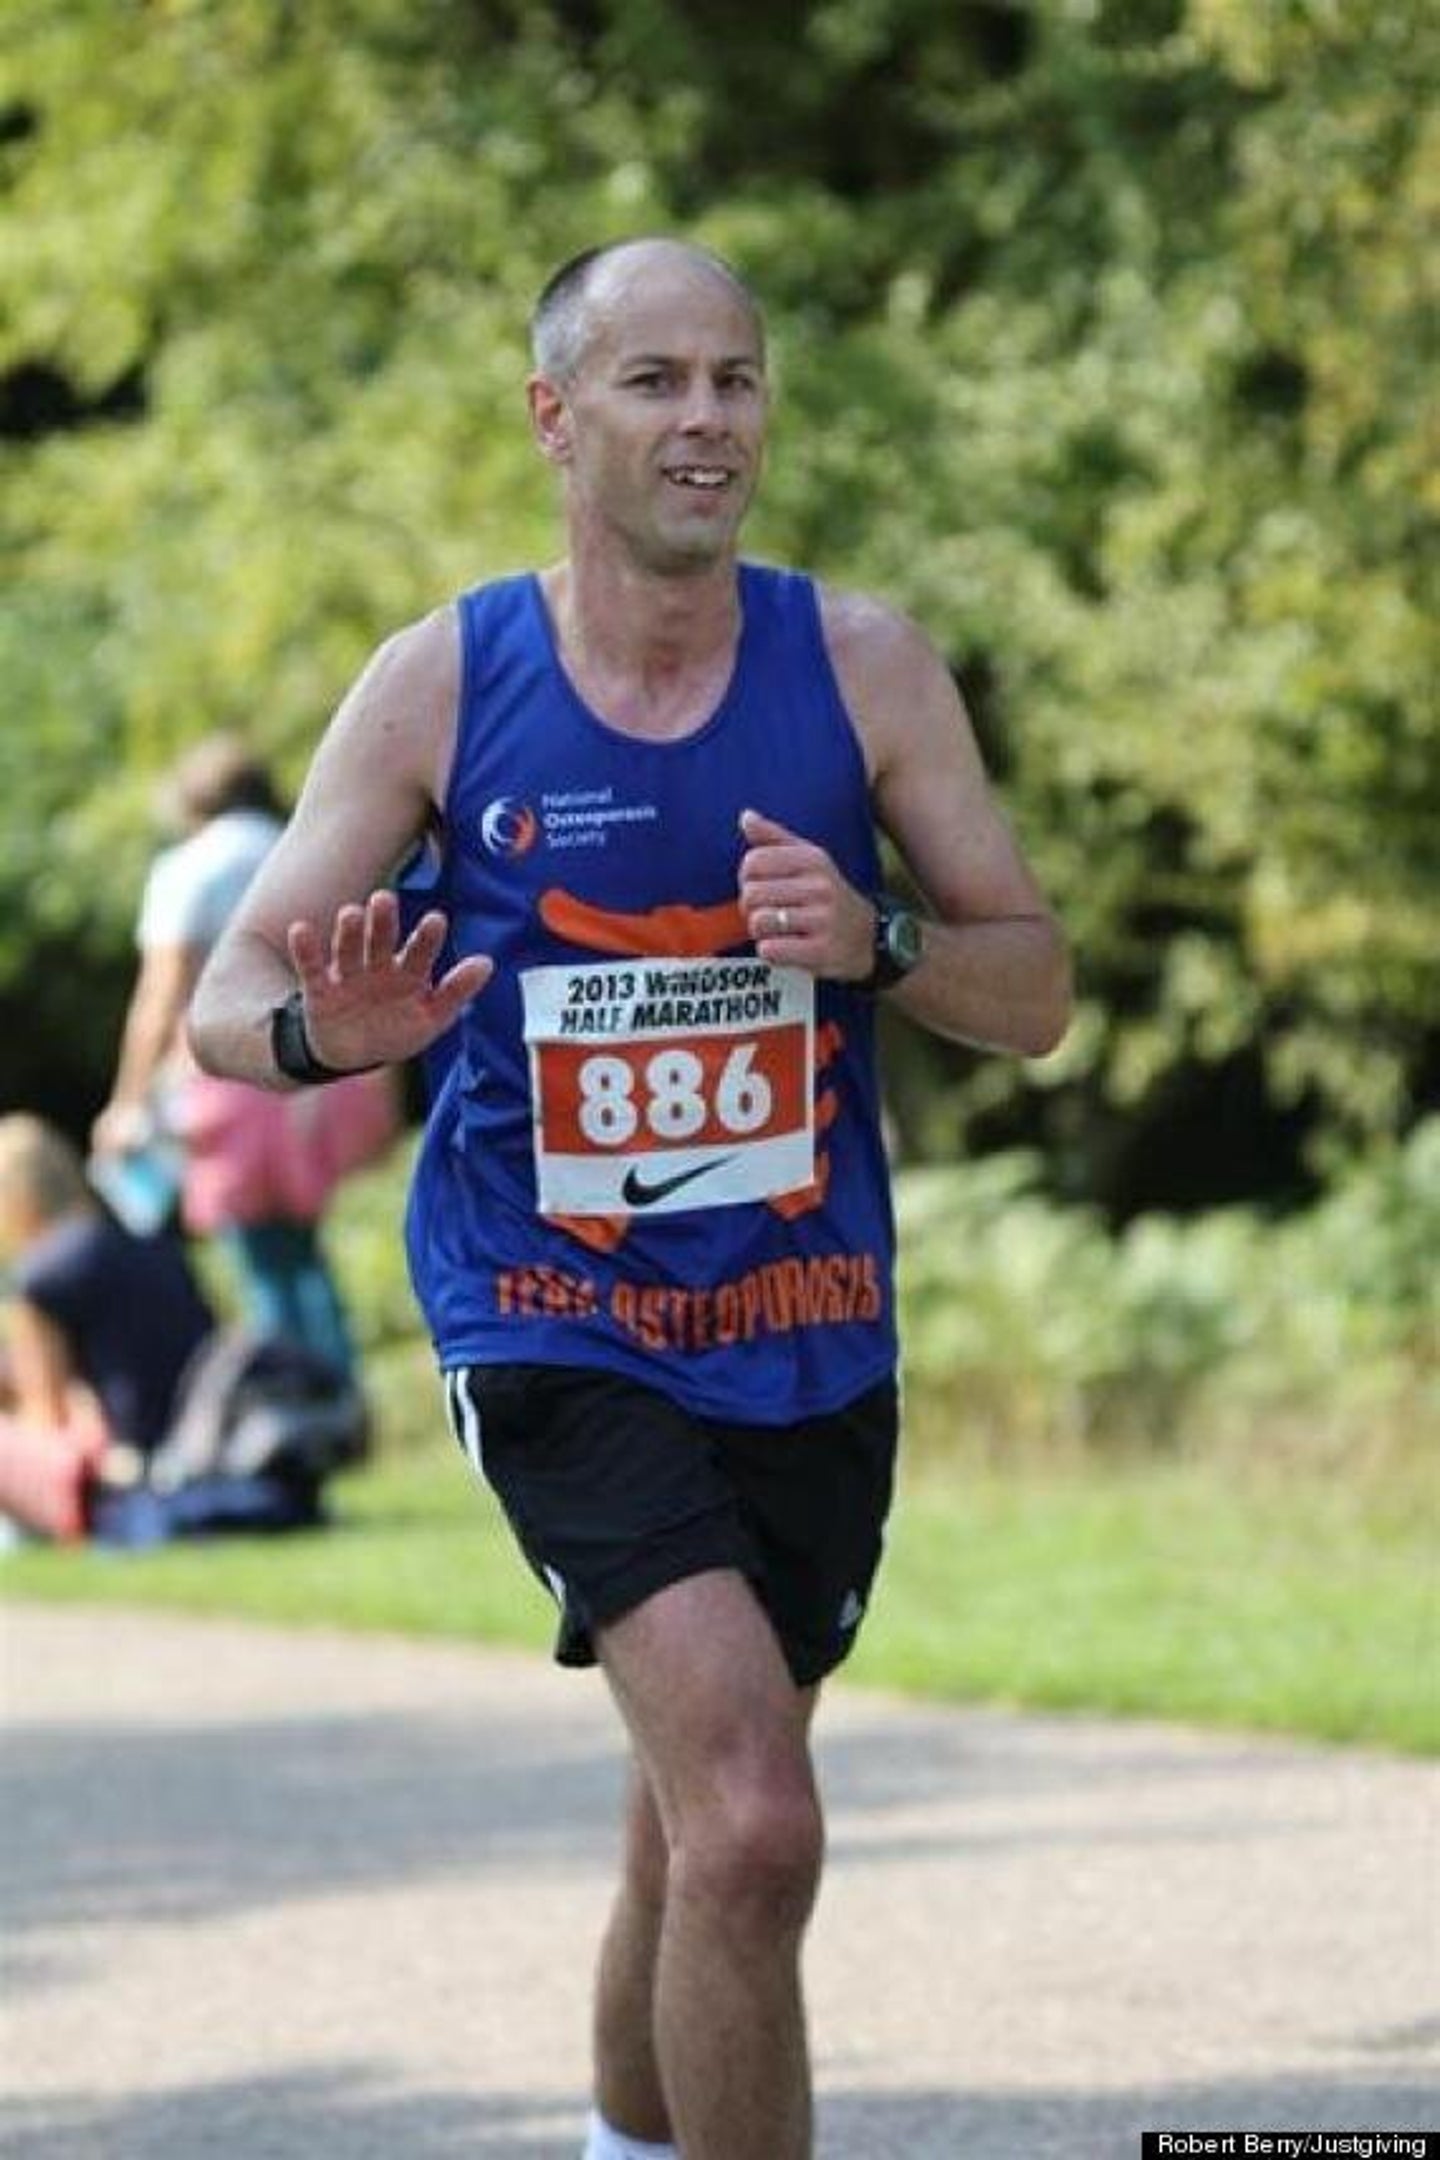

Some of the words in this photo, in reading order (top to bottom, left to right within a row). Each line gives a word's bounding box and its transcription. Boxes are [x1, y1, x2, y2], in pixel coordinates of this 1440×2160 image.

[568, 973, 635, 1004] 2013
[645, 966, 771, 995] WINDSOR
[559, 1007, 621, 1033] HALF
[631, 992, 780, 1030] MARATHON
[578, 1043, 773, 1146] 886
